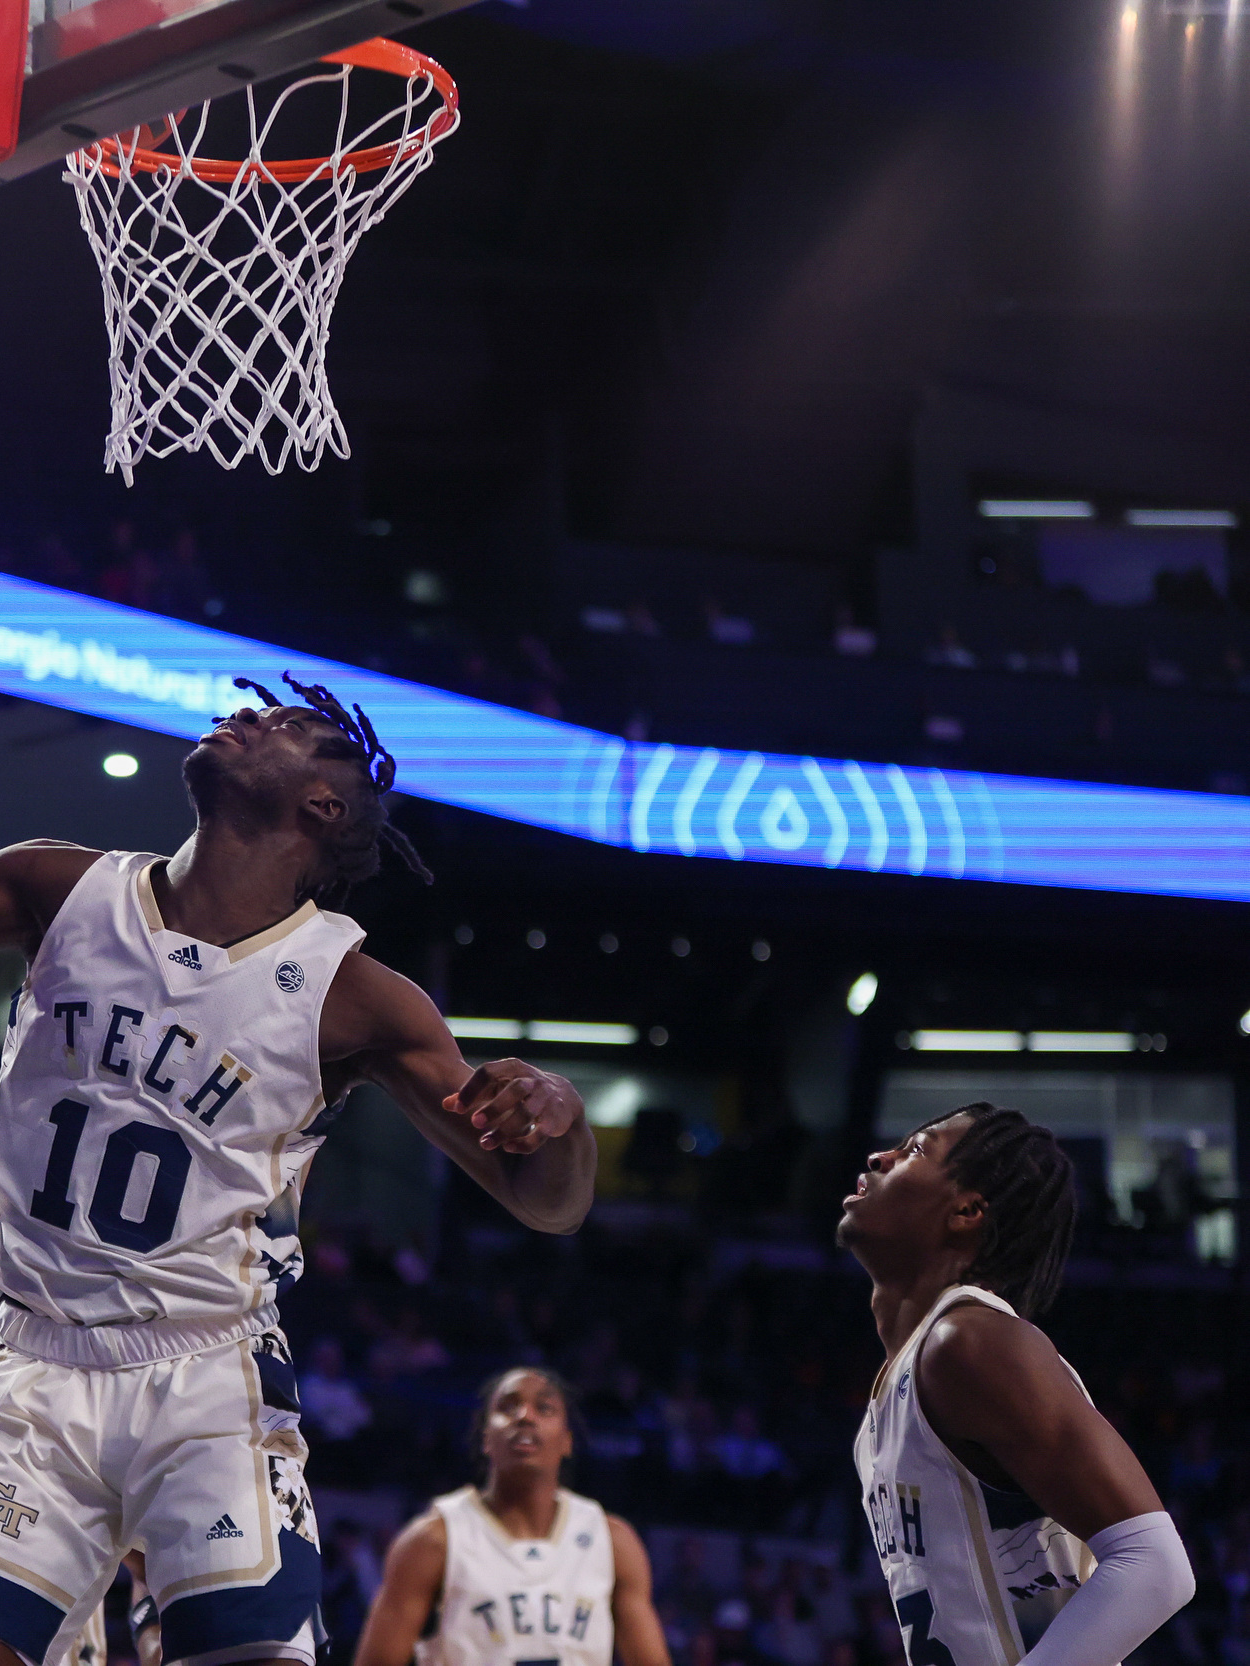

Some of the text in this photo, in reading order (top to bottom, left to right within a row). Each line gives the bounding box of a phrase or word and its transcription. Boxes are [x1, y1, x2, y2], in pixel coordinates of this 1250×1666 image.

[167, 952, 203, 971] adidas
[54, 1001, 254, 1127] TECH
[29, 1098, 192, 1254] 10
[206, 1529, 244, 1540] adidas
[471, 1592, 594, 1642] TECH
